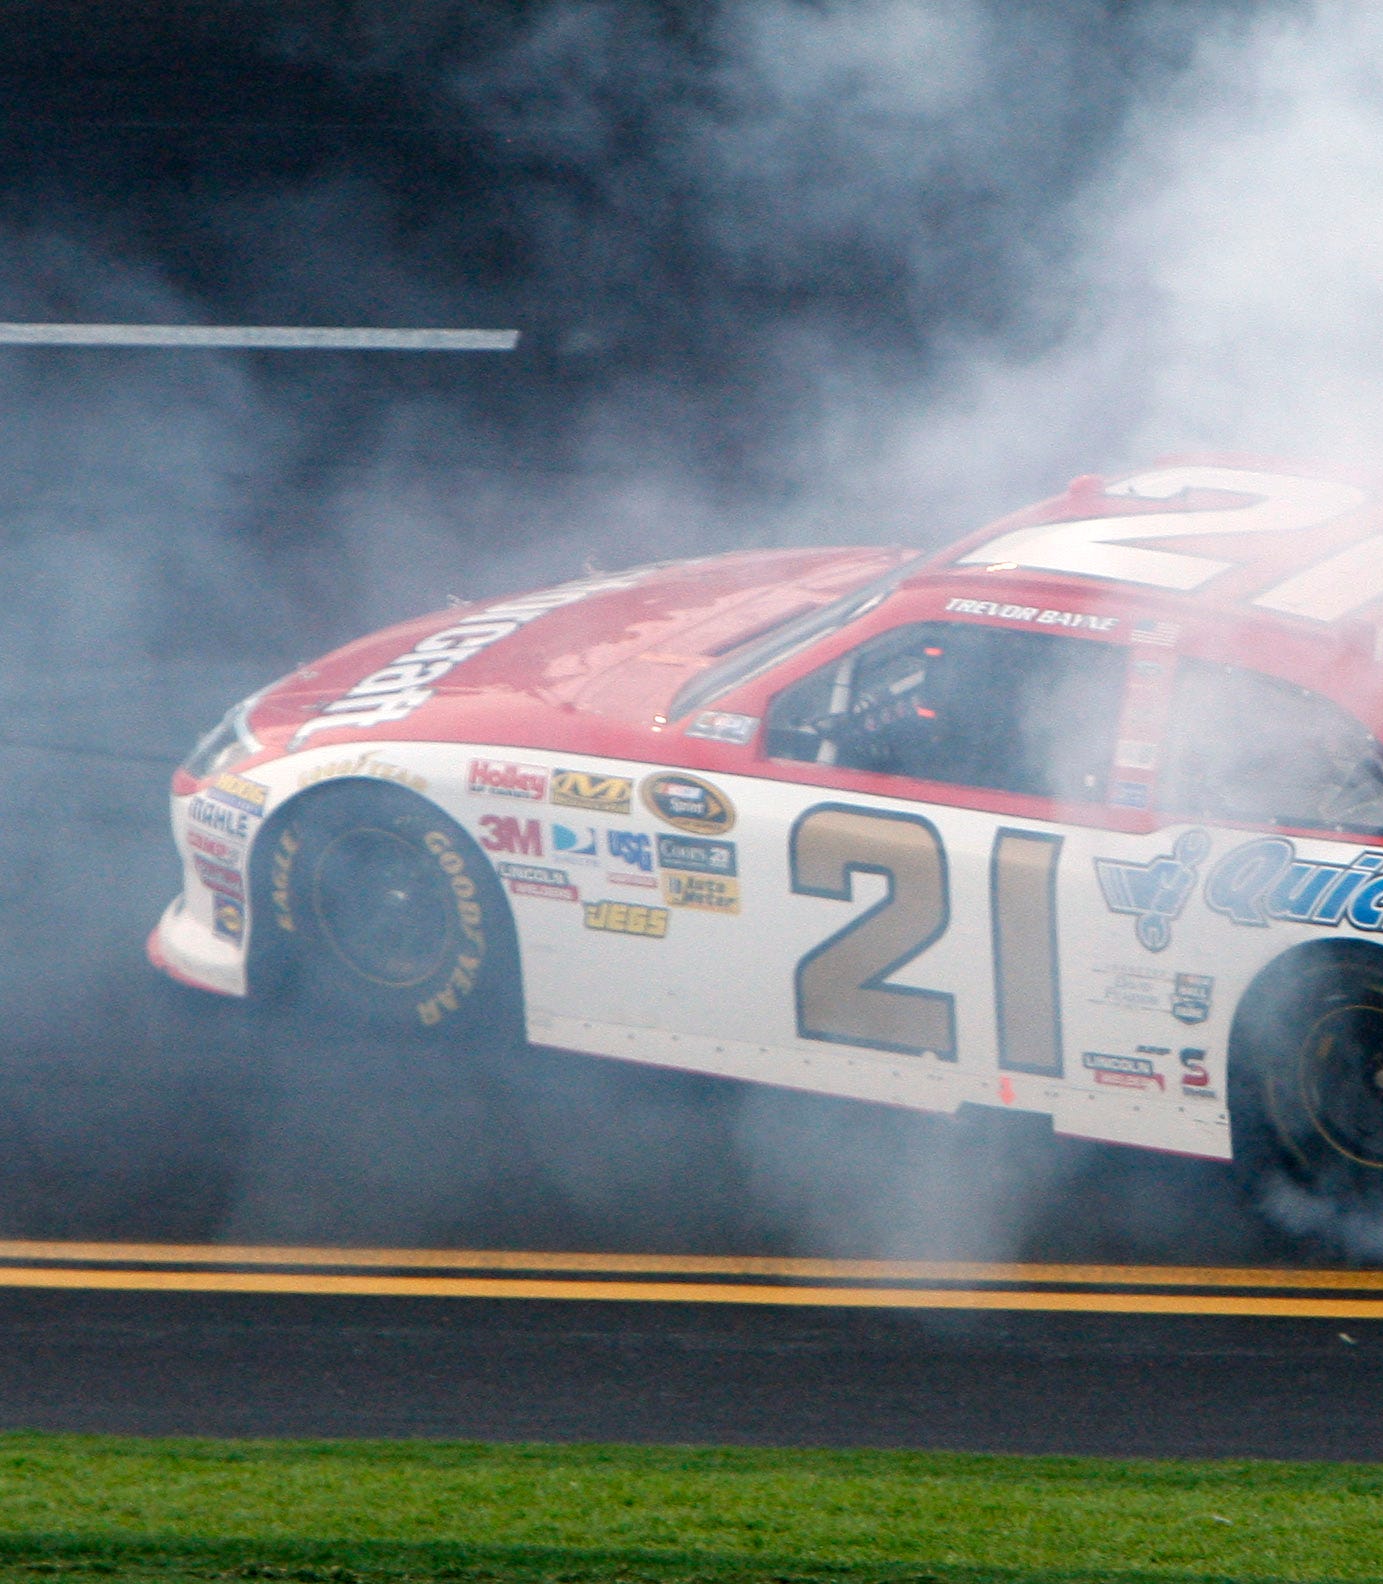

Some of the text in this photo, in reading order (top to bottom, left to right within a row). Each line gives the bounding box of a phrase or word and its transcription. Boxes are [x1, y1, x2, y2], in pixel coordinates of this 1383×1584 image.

[945, 598, 1121, 631] TREVOR BAYNE
[468, 760, 546, 800] Holley
[479, 814, 545, 857] 3M
[584, 901, 670, 938] JEGS
[789, 801, 1064, 1078] 21
